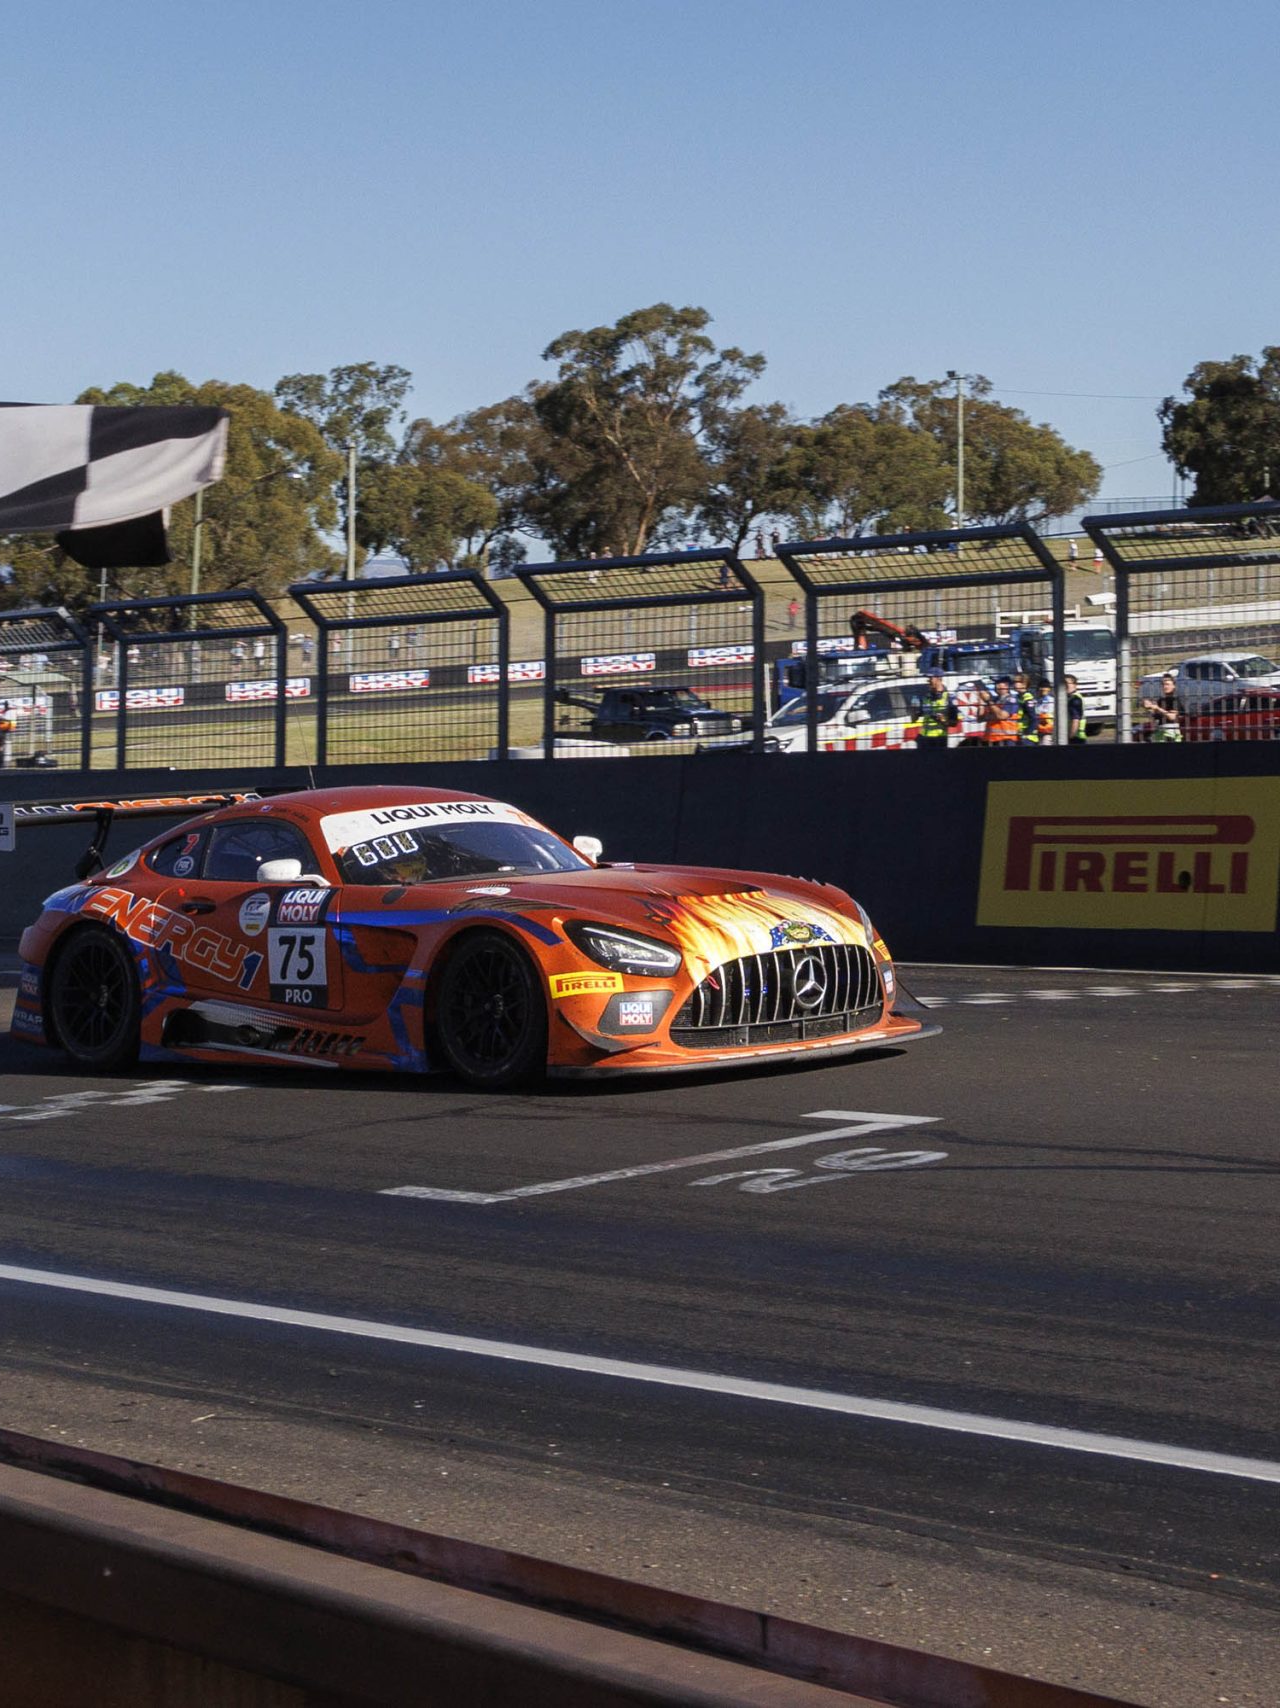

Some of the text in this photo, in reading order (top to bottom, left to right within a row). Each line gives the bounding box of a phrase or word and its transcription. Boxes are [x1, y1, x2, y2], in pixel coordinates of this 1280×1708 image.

[693, 646, 754, 657] LIQU
[370, 803, 495, 825] LIQUI MOLY
[1004, 815, 1255, 894] PIRELLI
[284, 888, 326, 904] LIQUI
[280, 904, 319, 921] MOLY
[278, 934, 315, 981] 75
[556, 975, 617, 993] PIRELLI
[285, 989, 313, 1004] PRO
[621, 1002, 652, 1013] LIQUI
[621, 1013, 652, 1024] MOLY
